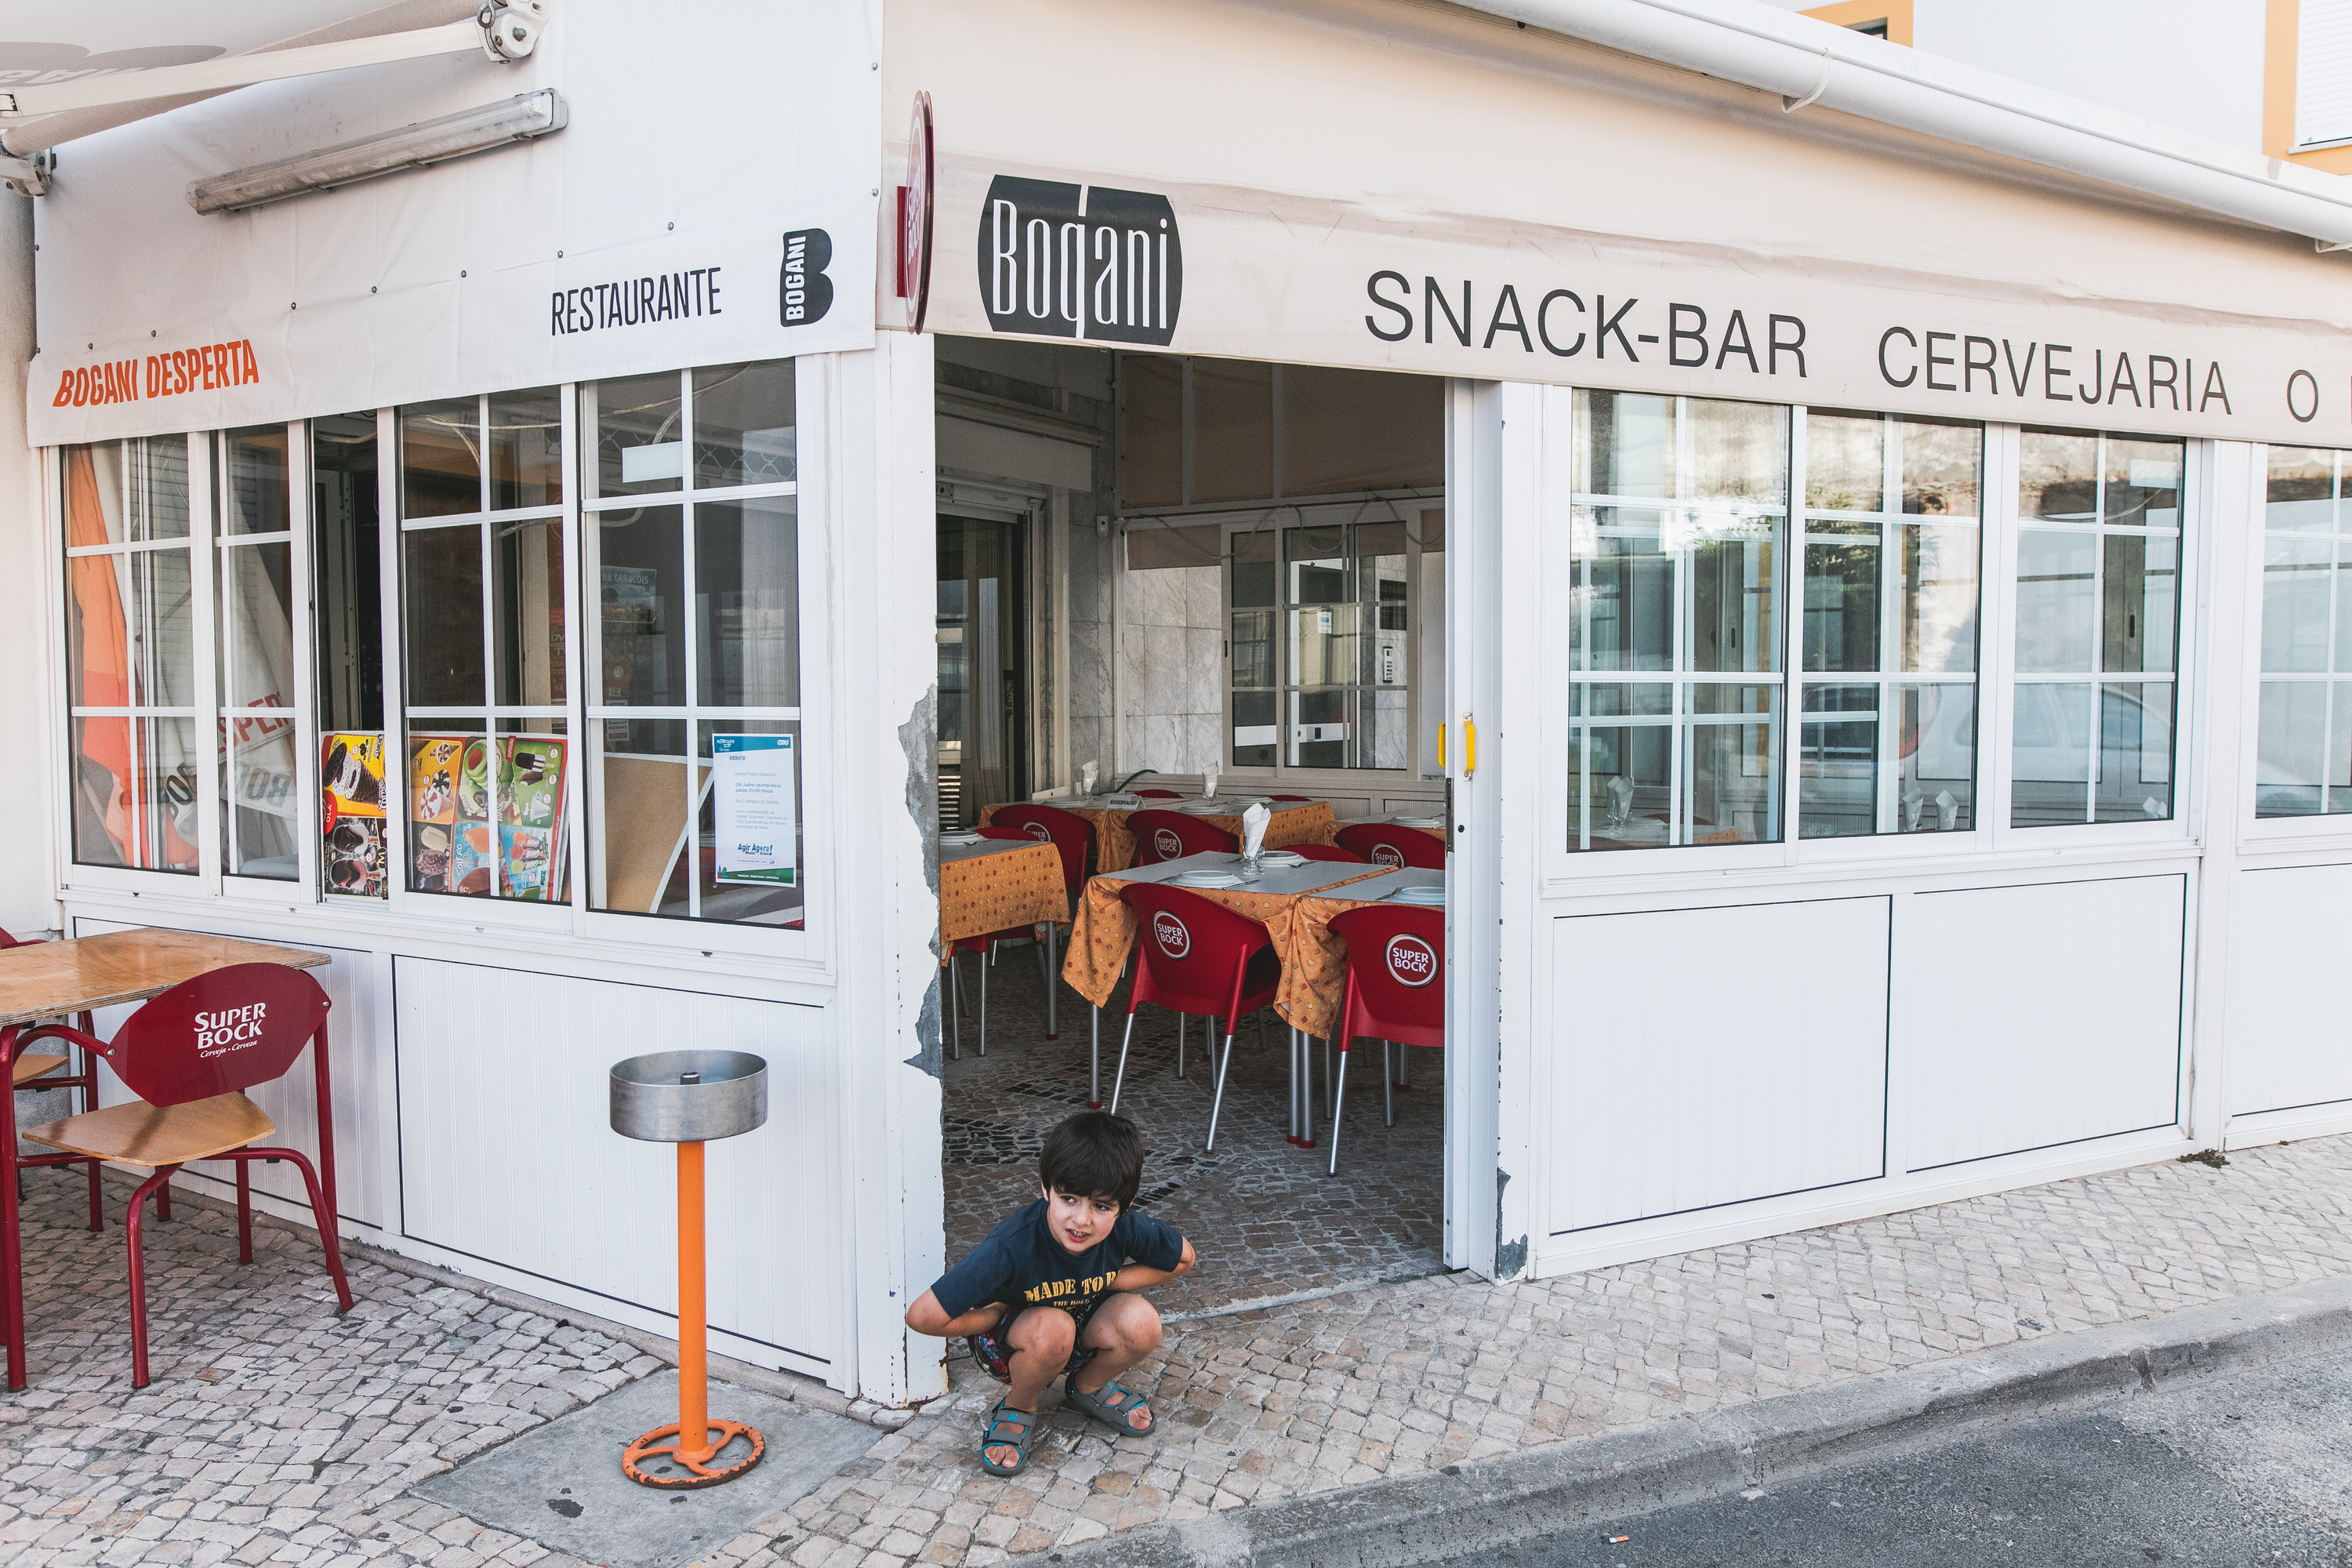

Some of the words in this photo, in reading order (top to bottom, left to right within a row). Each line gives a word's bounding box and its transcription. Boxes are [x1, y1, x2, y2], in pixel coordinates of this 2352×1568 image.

[786, 234, 807, 321] BOGANI
[993, 198, 1168, 339] Bogani
[550, 267, 722, 337] RESTAURANTE
[1365, 270, 1808, 379] SNACK-BAR
[1878, 325, 2233, 416] CERVEJARIA
[2286, 368, 2320, 423] O
[53, 358, 139, 408] BOGANI
[146, 339, 260, 400] DESPERTA
[737, 843, 751, 852] Agir
[1157, 837, 1178, 846] SUPER
[1159, 844, 1178, 853] BOCK
[1374, 852, 1399, 862] SUPER
[1156, 922, 1184, 938] SUPER
[1160, 933, 1184, 947] BOCK
[1392, 946, 1429, 964] SUPER
[1393, 957, 1428, 974] BOCK
[194, 1002, 267, 1033] SUPER
[197, 1019, 263, 1050] BOCK
[200, 1047, 227, 1058] Cerveja
[231, 1040, 258, 1051] Cerveza
[1024, 1278, 1076, 1302] MADE
[1081, 1276, 1104, 1295] TO
